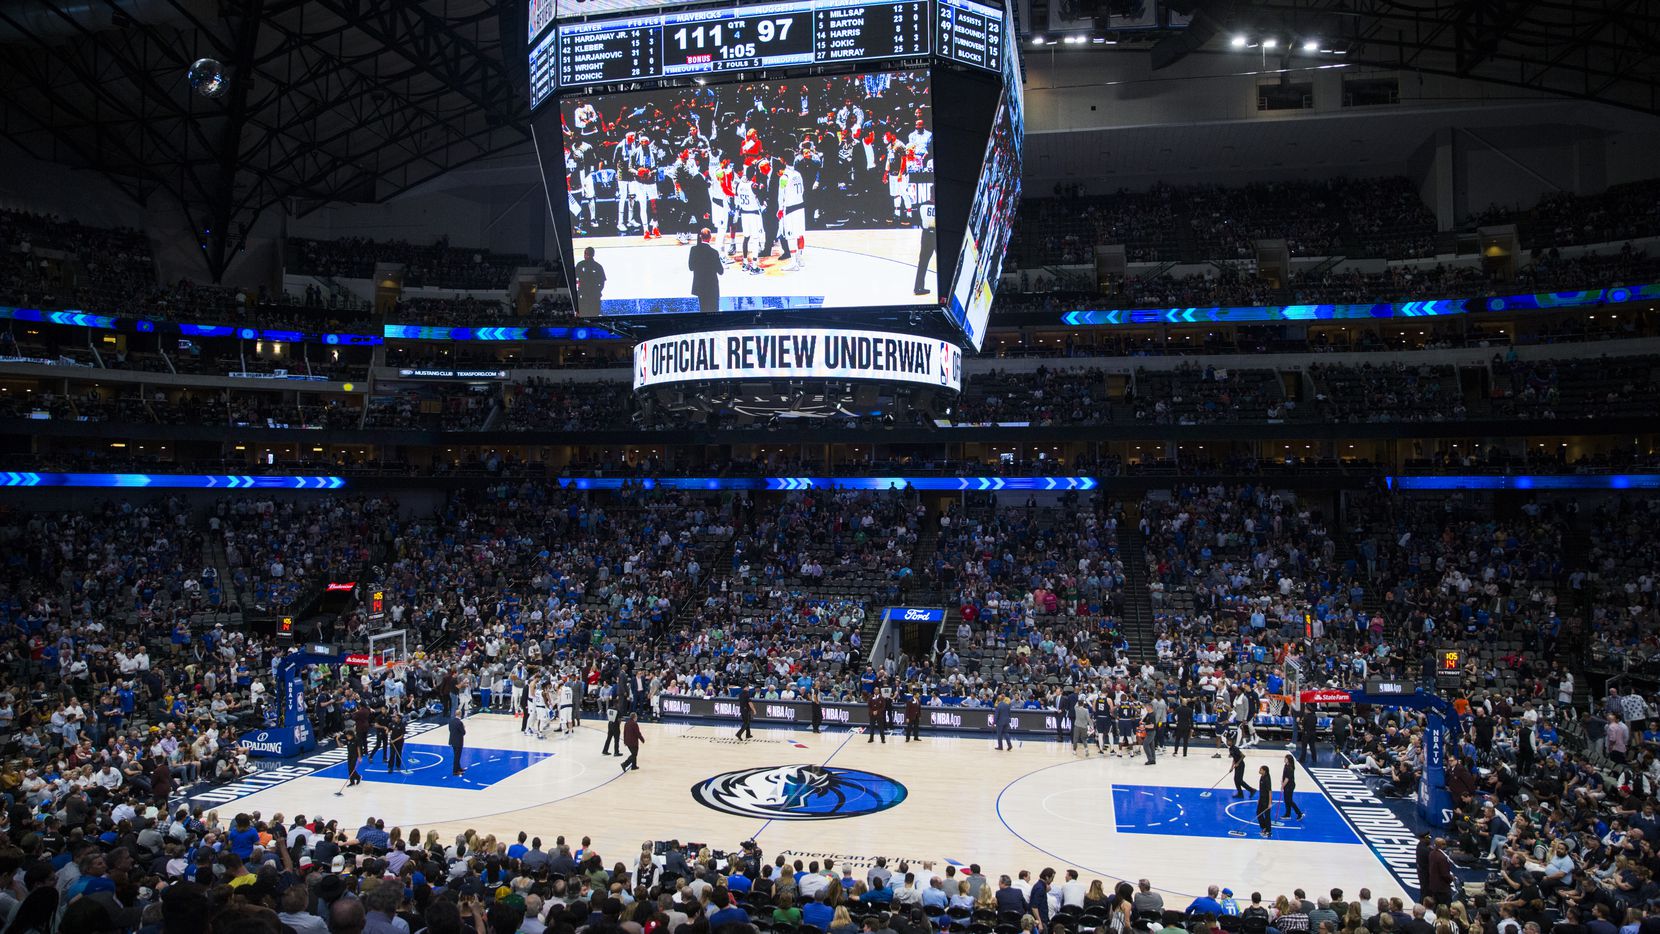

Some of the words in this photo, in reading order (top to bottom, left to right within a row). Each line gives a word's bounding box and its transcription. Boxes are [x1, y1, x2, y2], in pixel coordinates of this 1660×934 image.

[676, 11, 721, 22] MAVERICKS
[830, 8, 865, 18] MILLSAP
[728, 20, 746, 29] QTR
[830, 19, 864, 28] BARTON
[940, 8, 951, 18] 23
[958, 14, 982, 26] ASSISTS
[988, 23, 999, 33] 23
[574, 25, 602, 33] PLAYER
[674, 24, 722, 50] 111
[757, 18, 793, 43] 97
[830, 29, 860, 38] HARRIS
[940, 20, 951, 30] 49
[955, 25, 985, 39] REBOUNDS
[988, 35, 999, 44] 39
[574, 33, 615, 43] HARDAWAY
[616, 31, 628, 39] JR.
[734, 31, 740, 39] 4
[830, 39, 854, 48] JOKIC
[893, 35, 903, 43] 14
[943, 33, 949, 42] 9
[955, 37, 985, 51] TURNOVERS
[988, 46, 998, 56] 15
[574, 43, 604, 53] KLEBER
[719, 43, 755, 59] 1:05
[830, 48, 865, 58] MURRAY
[574, 51, 623, 62] MARJANOVIC
[687, 55, 711, 64] BONUS
[942, 45, 948, 55] 2
[958, 50, 981, 62] BLOCKS
[990, 59, 996, 68] 4
[574, 62, 604, 72] WRIGHT
[665, 66, 699, 74] TIMEOUTS
[703, 63, 708, 71] 2
[726, 61, 748, 69] FOULS
[754, 59, 759, 67] 5
[574, 72, 603, 81] DONCIC
[740, 194, 750, 205] 55
[652, 337, 719, 376] OFFICIAL
[726, 335, 817, 369] REVIEW
[824, 335, 932, 375] UNDERWAY
[904, 608, 930, 621] Ford
[1445, 660, 1455, 668] 14
[288, 700, 293, 710] TV
[668, 700, 681, 712] NBA
[680, 701, 690, 714] App
[719, 703, 732, 714] NBA
[772, 705, 785, 717] NBA
[784, 706, 795, 720] App
[826, 708, 839, 720] NBA
[838, 709, 849, 722] App
[936, 712, 950, 724] NBA
[950, 713, 961, 727] App
[242, 740, 282, 754] SPALDING
[1433, 751, 1439, 764] TV
[189, 765, 315, 801] DALLAS
[1308, 767, 1383, 804] DALLAS
[780, 849, 865, 861] American
